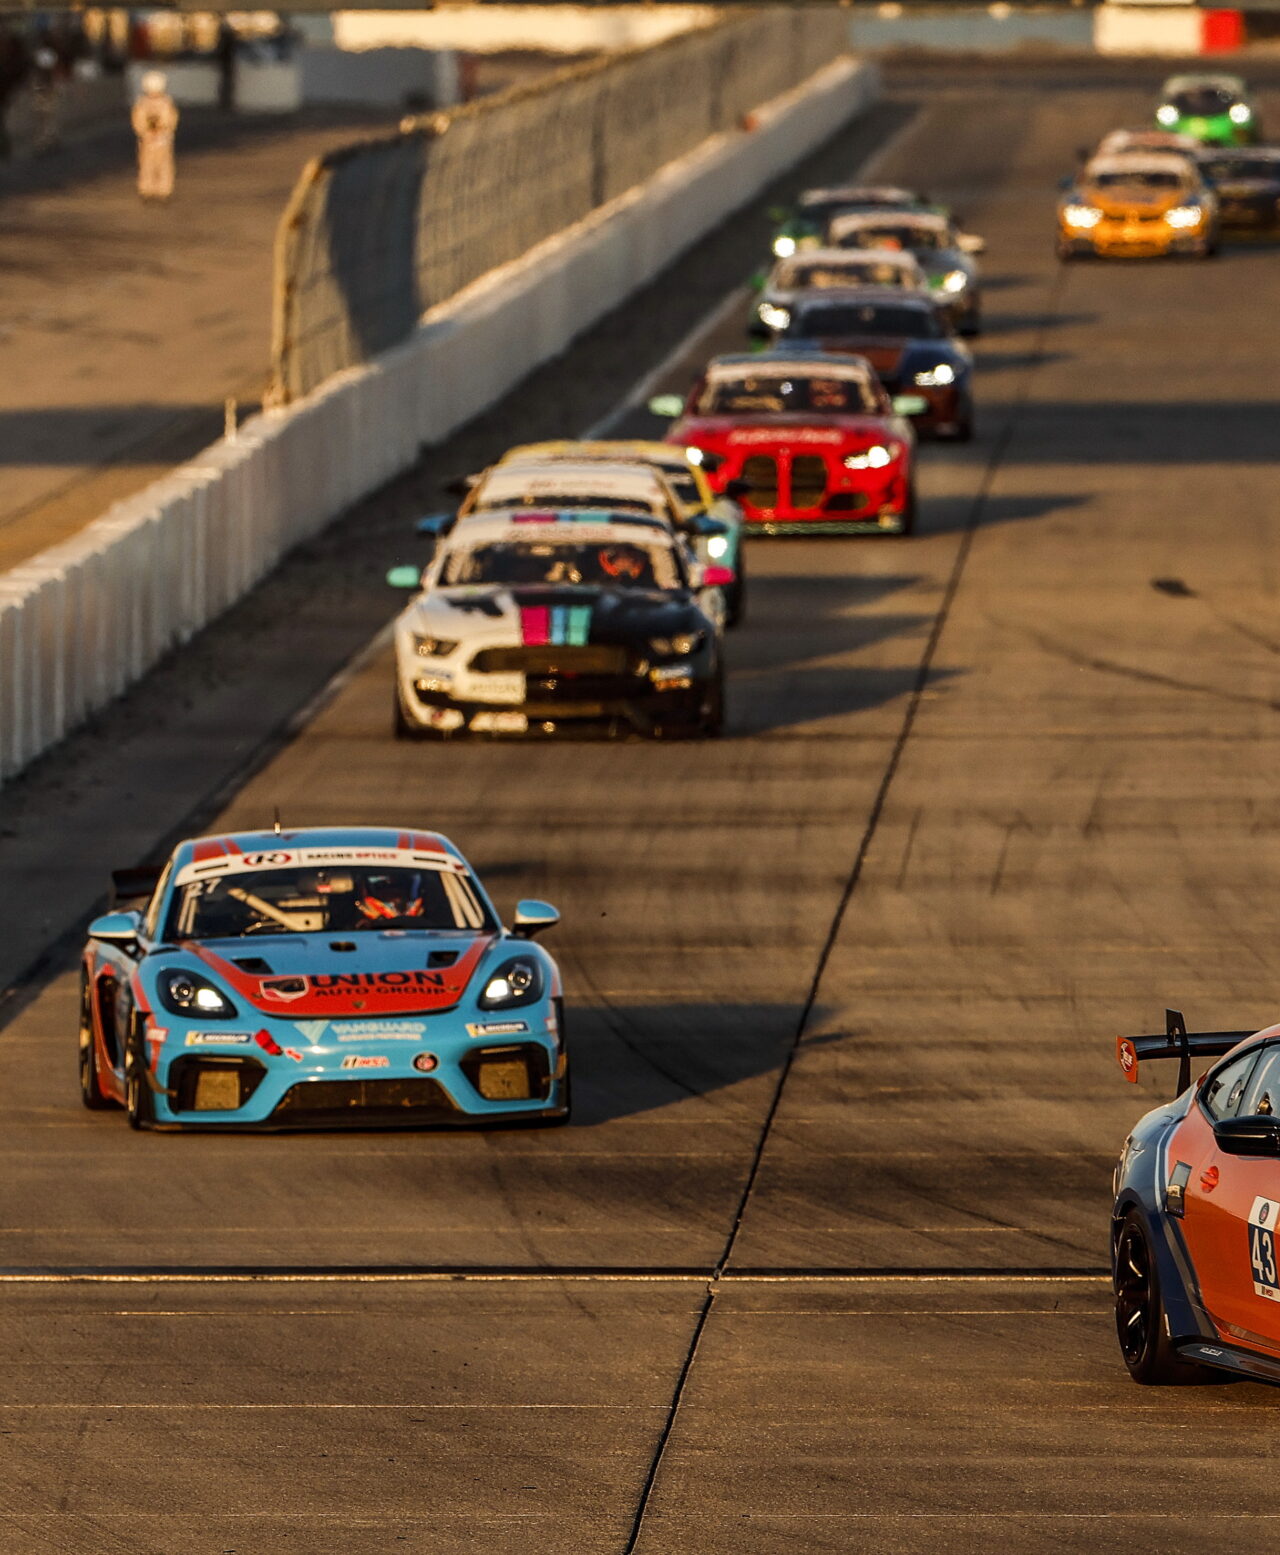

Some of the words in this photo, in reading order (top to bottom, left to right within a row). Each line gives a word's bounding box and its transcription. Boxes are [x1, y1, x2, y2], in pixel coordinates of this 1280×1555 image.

[309, 972, 444, 987] UNION
[315, 986, 369, 997] AUTO
[376, 985, 447, 995] GROUP
[331, 1021, 426, 1034] VANGUARD
[1251, 1228, 1276, 1285] 43
